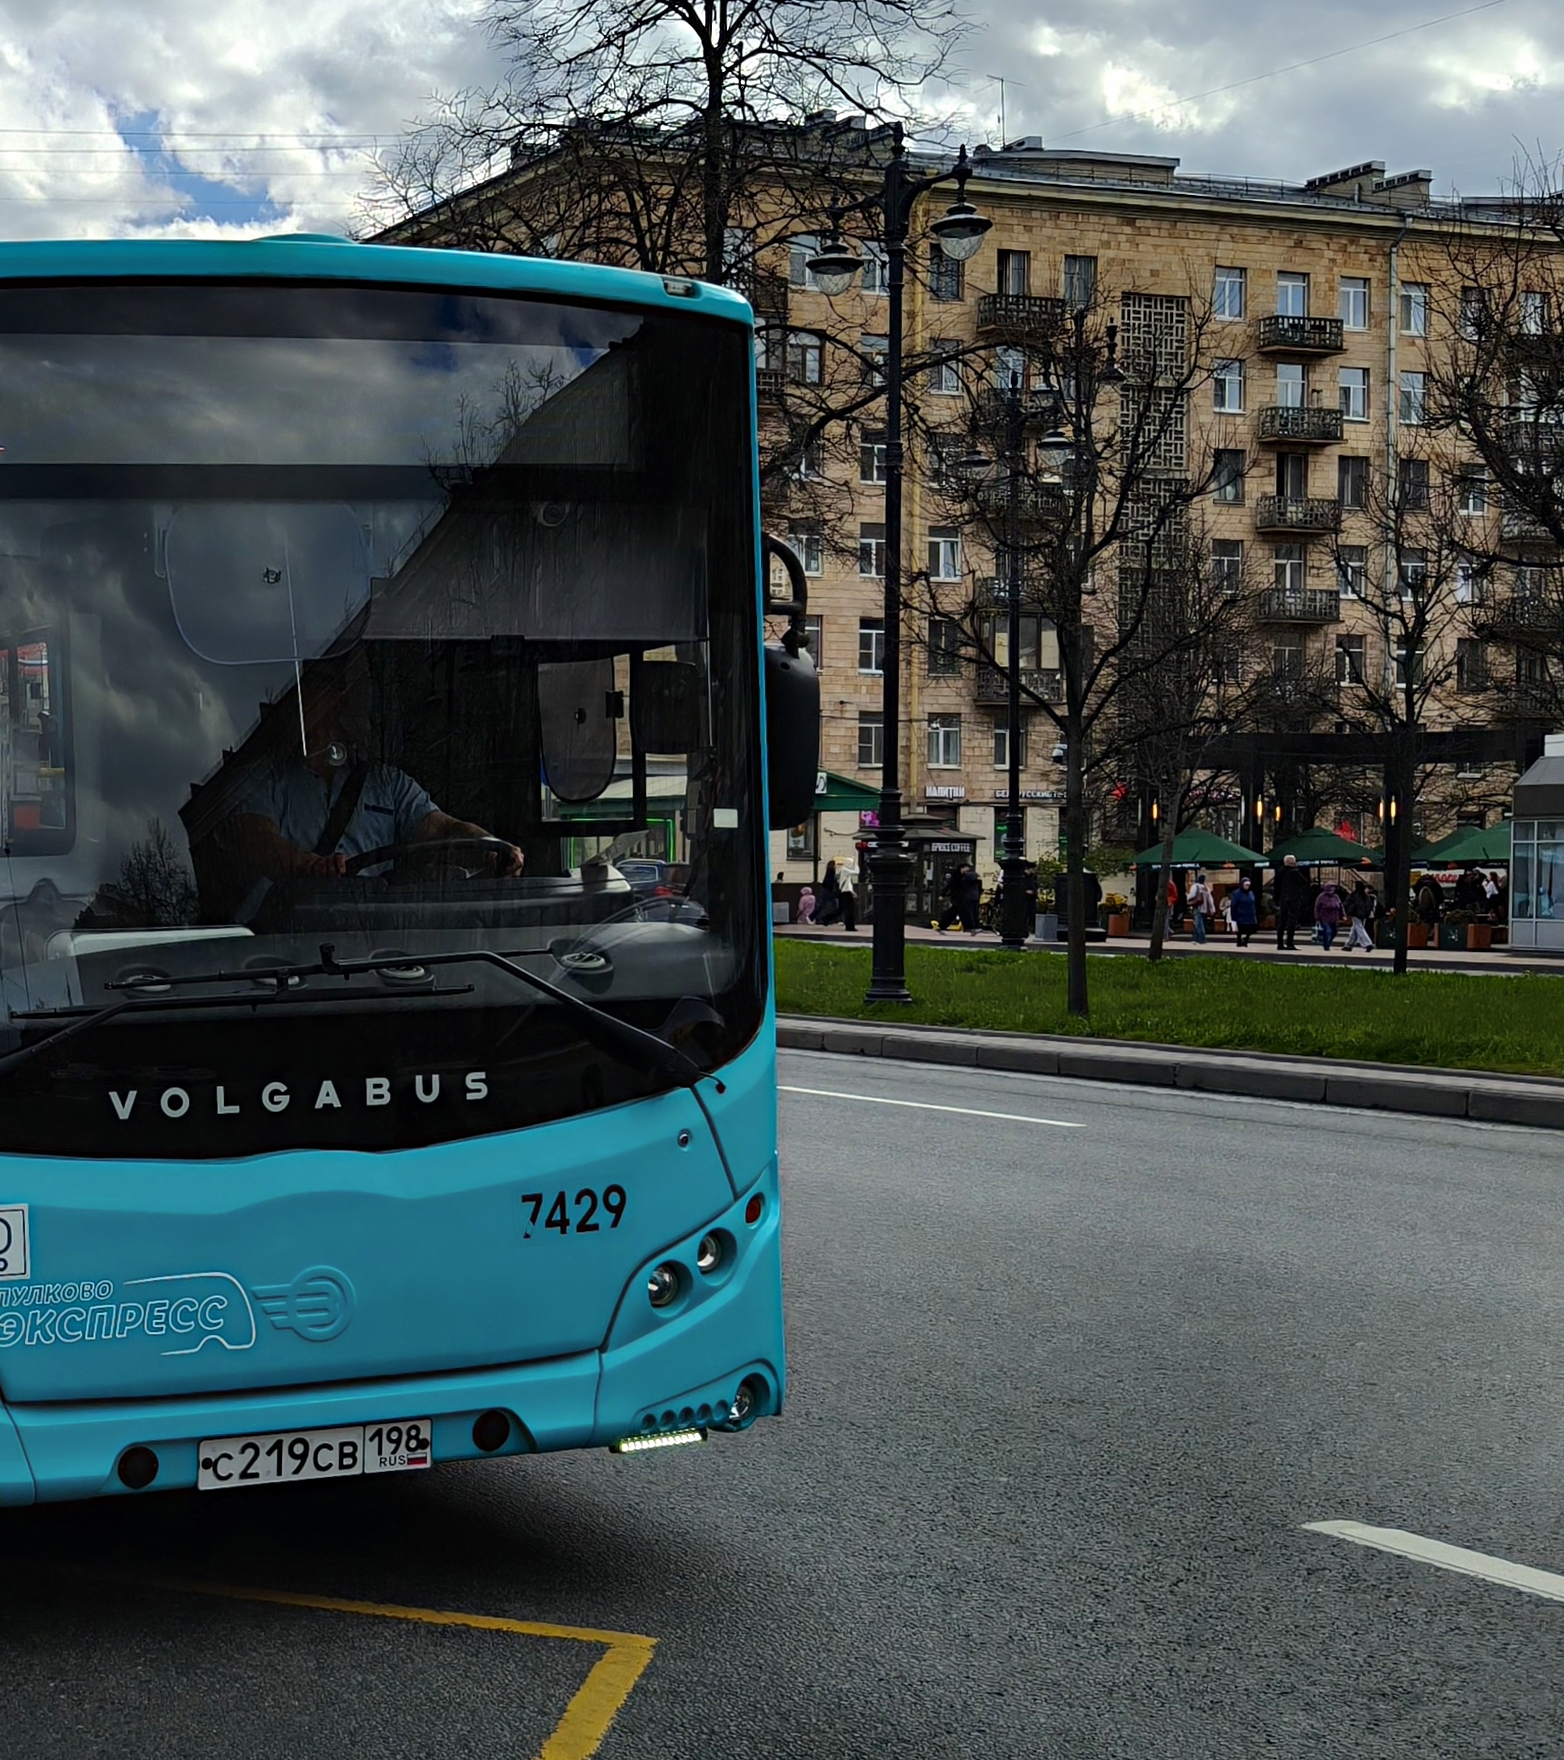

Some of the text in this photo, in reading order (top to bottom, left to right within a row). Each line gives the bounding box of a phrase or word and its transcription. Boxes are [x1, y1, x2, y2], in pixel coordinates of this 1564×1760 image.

[108, 1071, 489, 1120] VOLGABUS
[521, 1183, 627, 1239] 7429
[368, 1424, 422, 1456] 198
[379, 1454, 406, 1468] RUS
